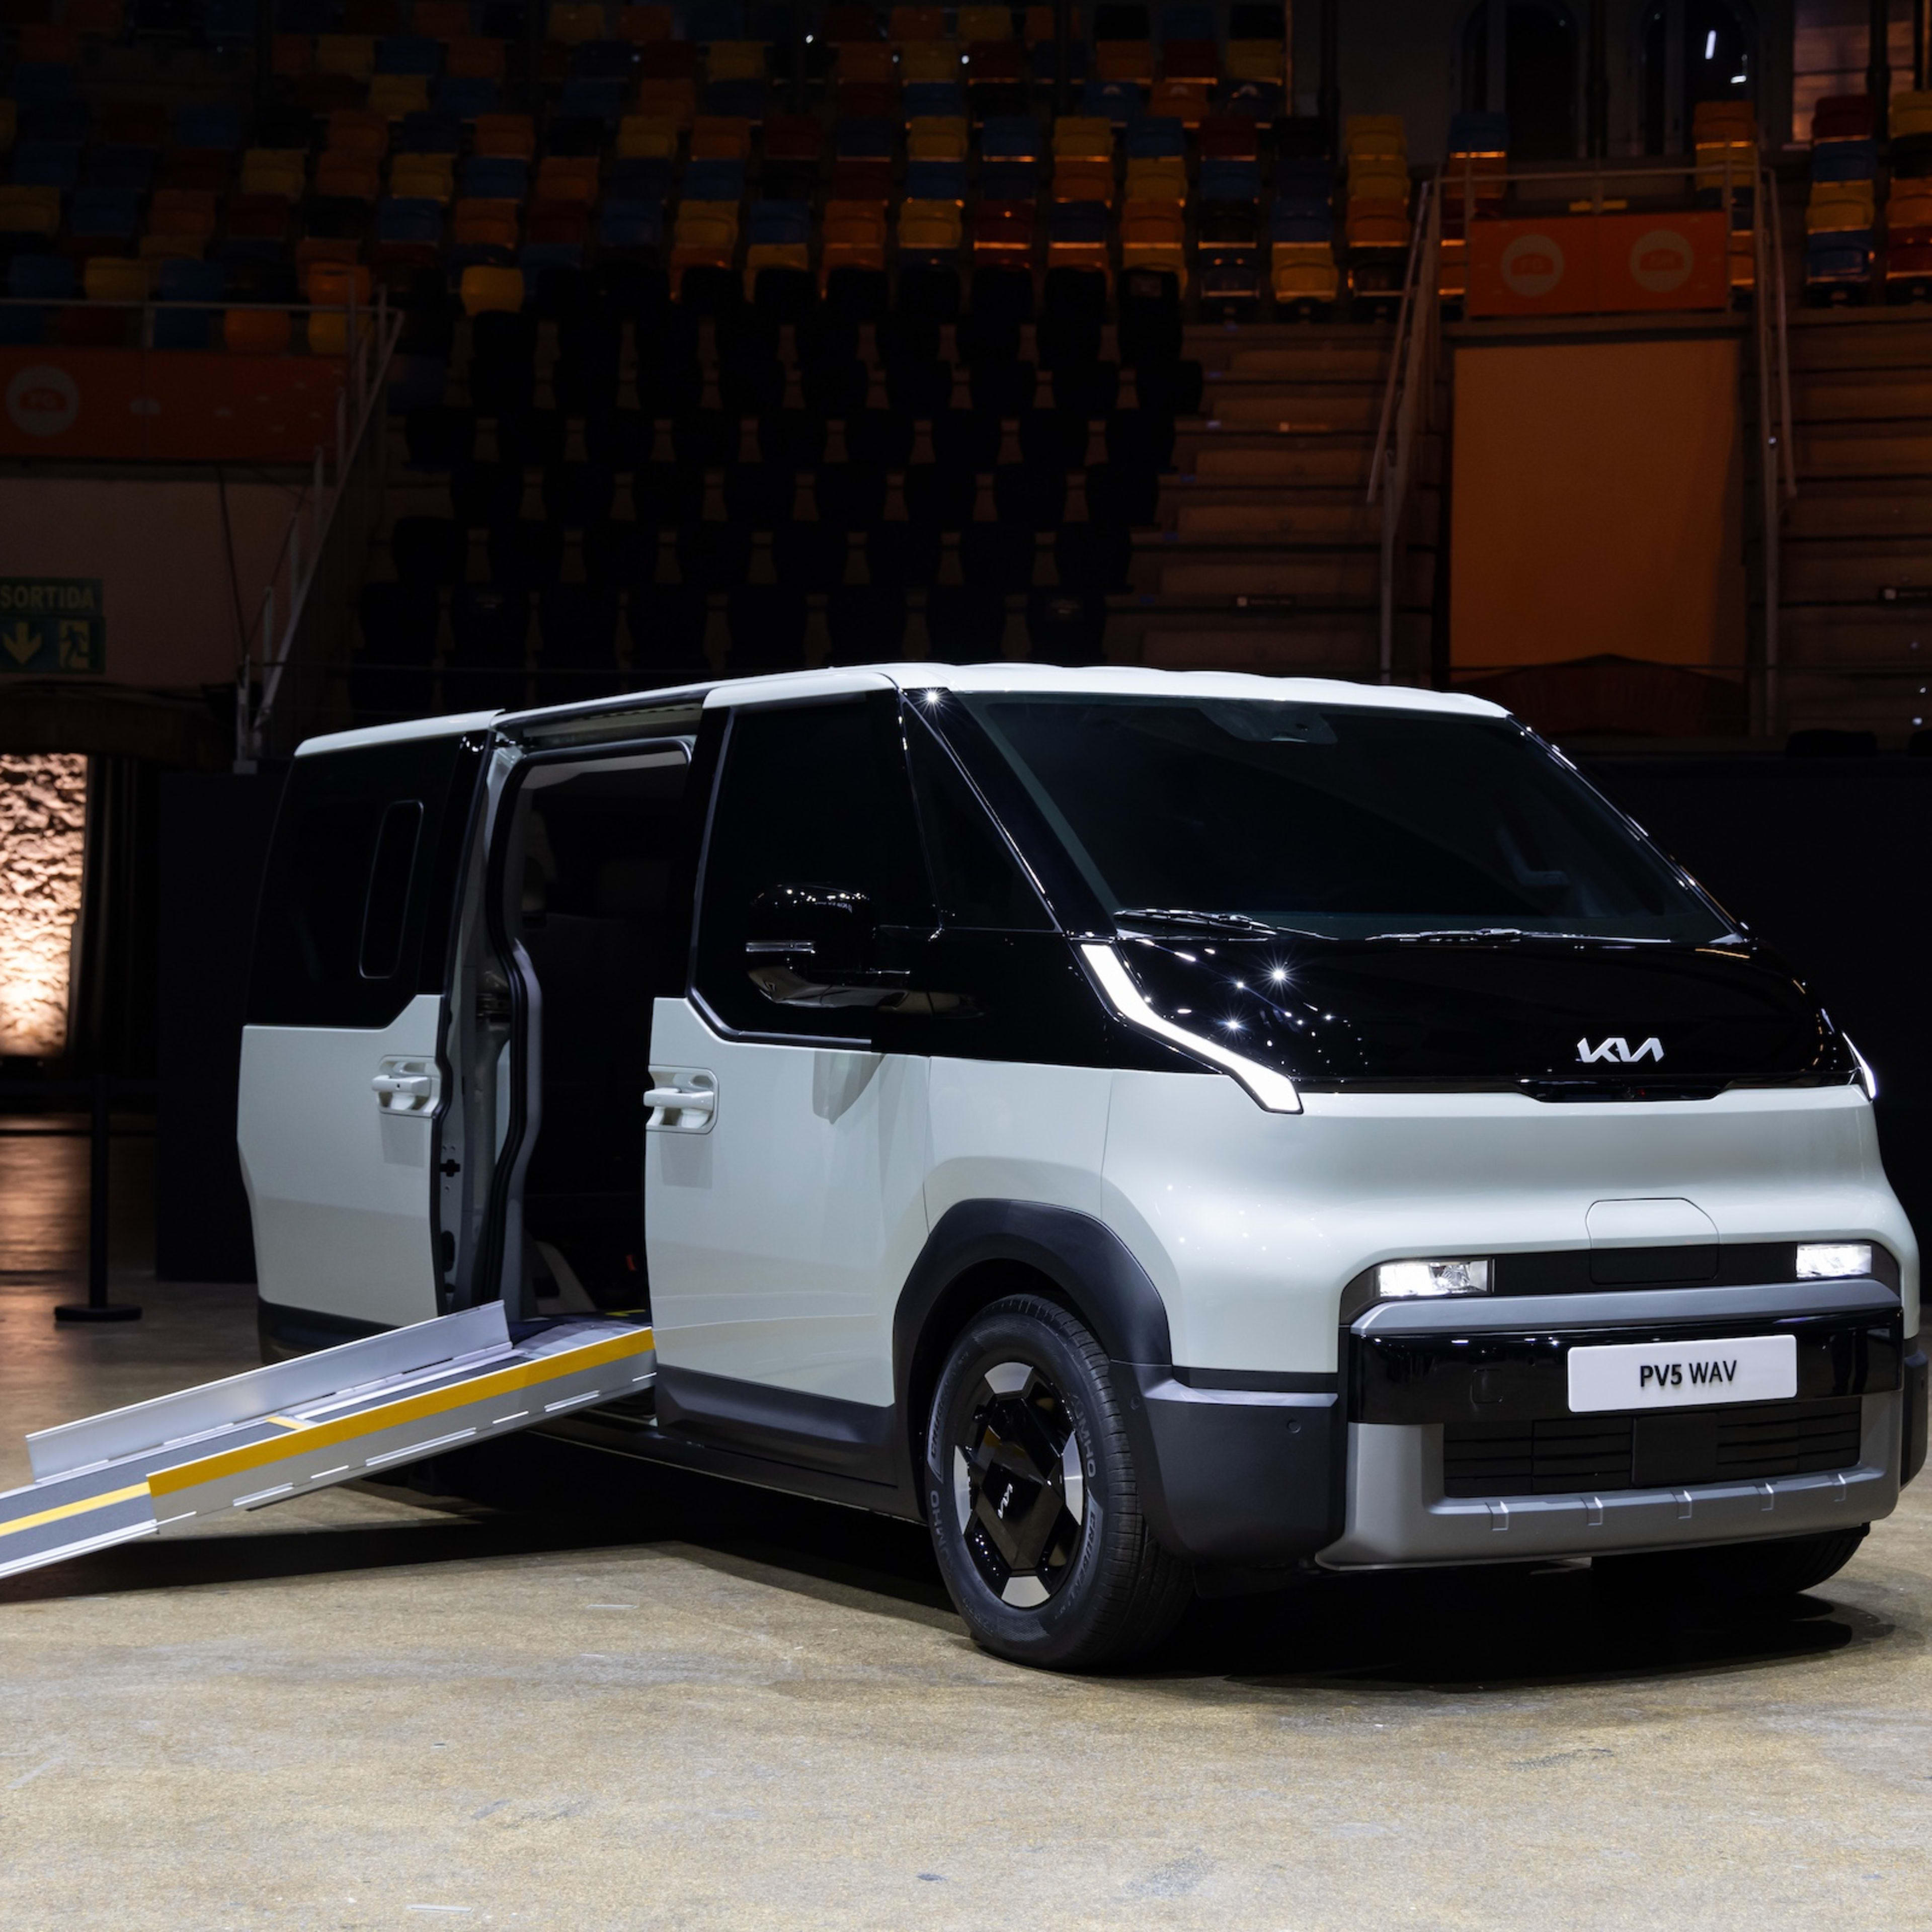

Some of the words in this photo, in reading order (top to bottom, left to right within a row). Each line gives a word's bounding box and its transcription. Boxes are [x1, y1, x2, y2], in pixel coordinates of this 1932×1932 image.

[0, 584, 96, 608] SORTIDA
[1576, 1037, 1665, 1063] KIA
[1640, 1363, 1682, 1387] PV5
[1688, 1359, 1737, 1384] WAV
